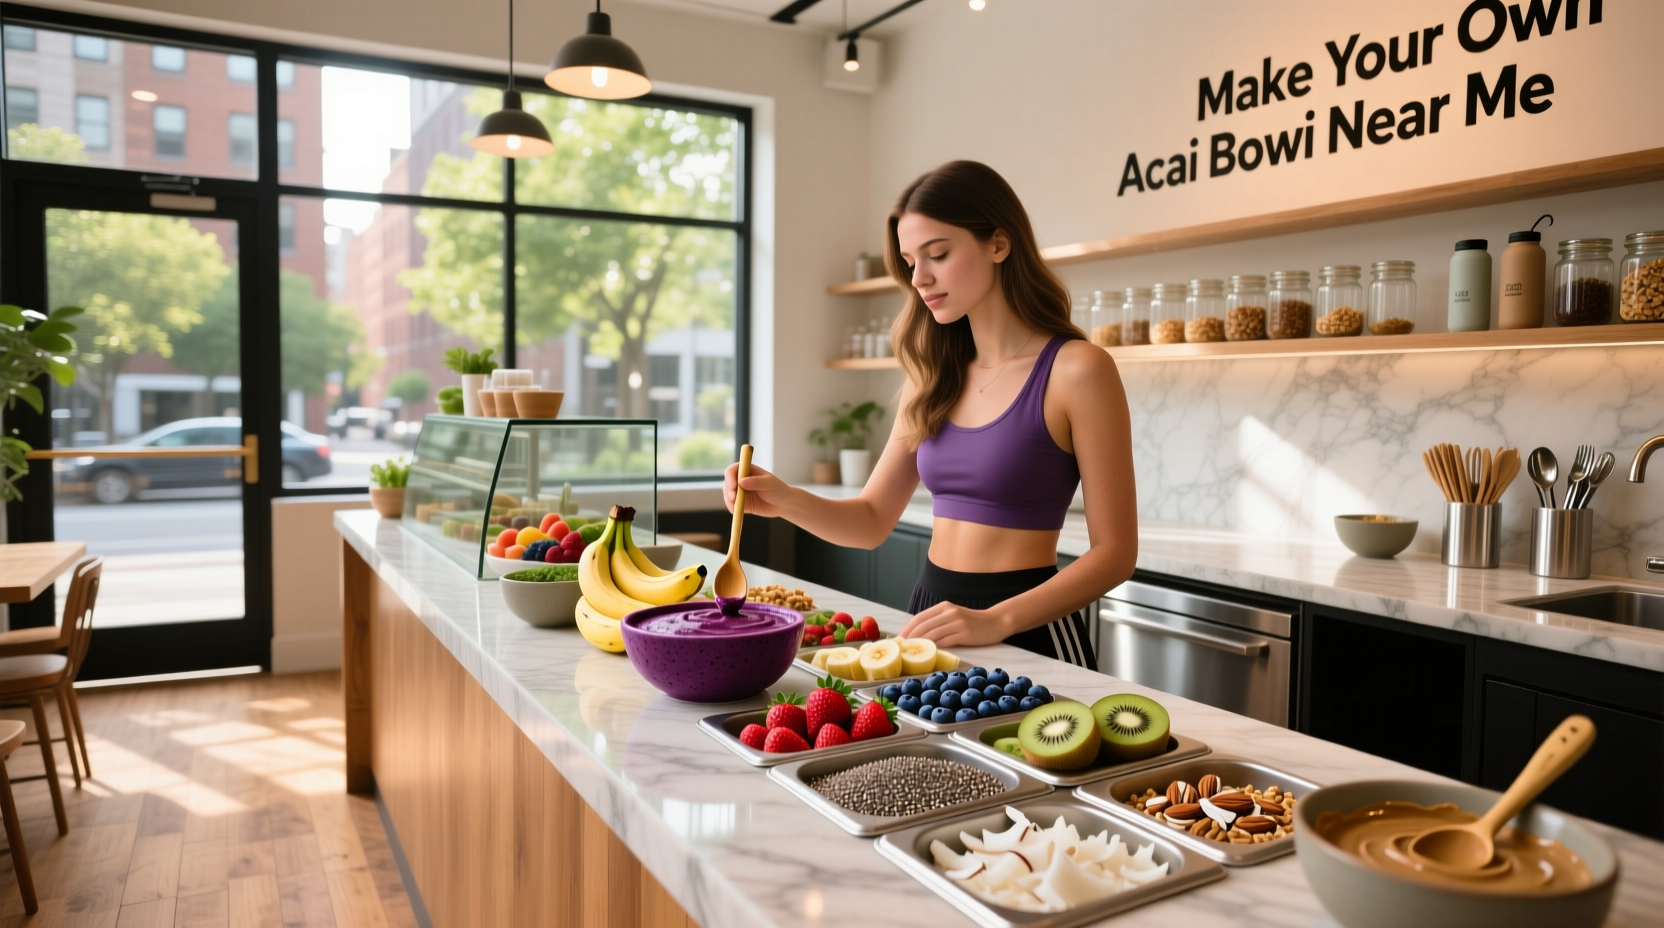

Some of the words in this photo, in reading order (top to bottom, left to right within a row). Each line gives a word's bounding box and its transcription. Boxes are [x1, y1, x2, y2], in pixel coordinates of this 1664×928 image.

[1197, 56, 1313, 122] Make
[1324, 23, 1444, 87] Your
[1457, 0, 1603, 54] Own
[1117, 137, 1199, 197] Acai
[1209, 109, 1315, 178] Bowi
[1328, 93, 1451, 154] Near
[1465, 63, 1555, 127] Me
